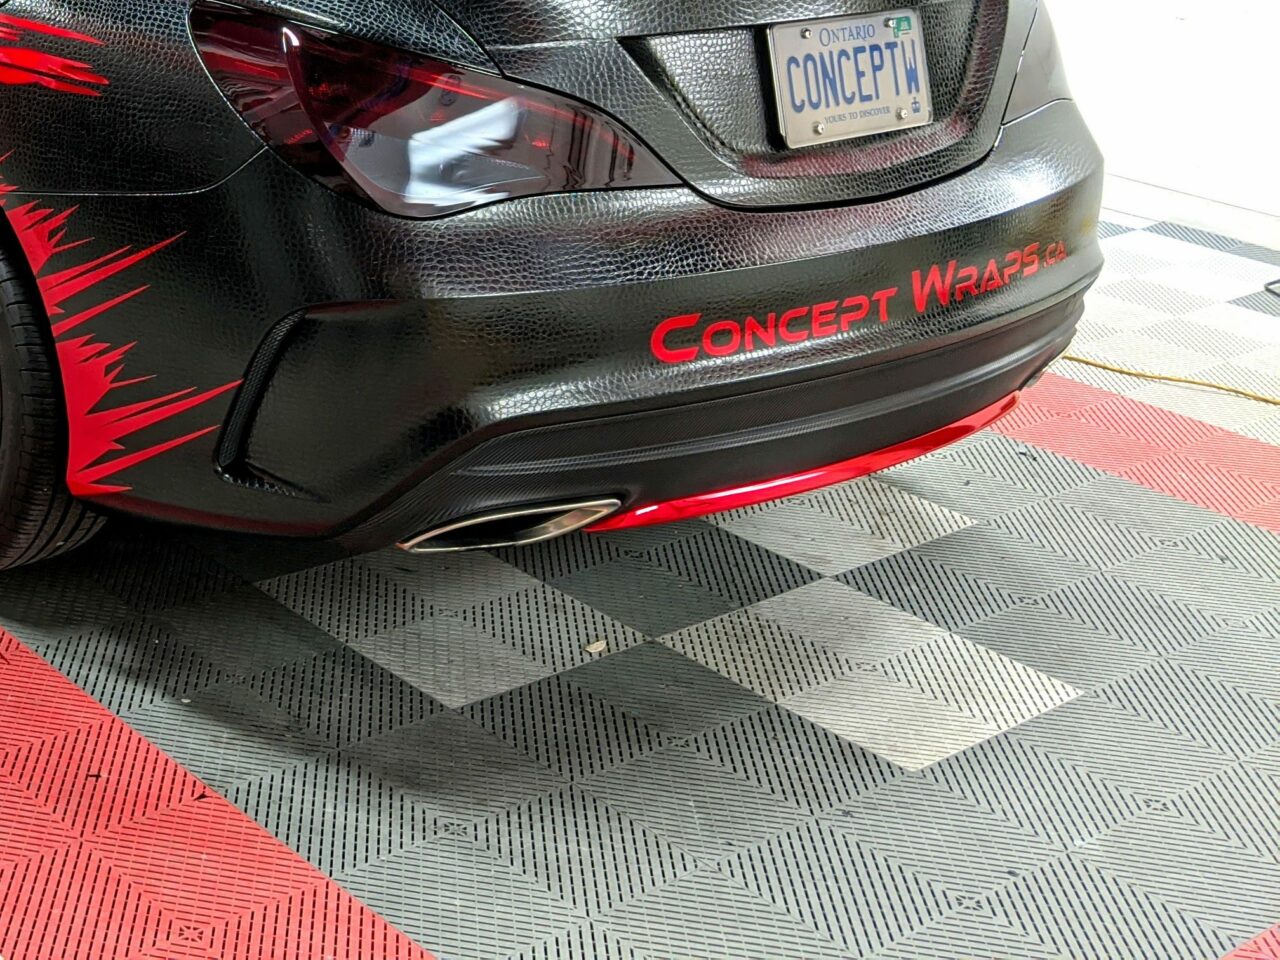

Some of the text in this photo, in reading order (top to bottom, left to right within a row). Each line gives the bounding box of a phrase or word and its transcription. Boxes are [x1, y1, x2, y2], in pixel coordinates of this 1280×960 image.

[819, 24, 876, 47] ONTARIO
[786, 39, 921, 114] CONCEPTW
[847, 111, 858, 121] TO
[859, 106, 891, 119] DISCOVER
[650, 287, 899, 364] CONCEPT
